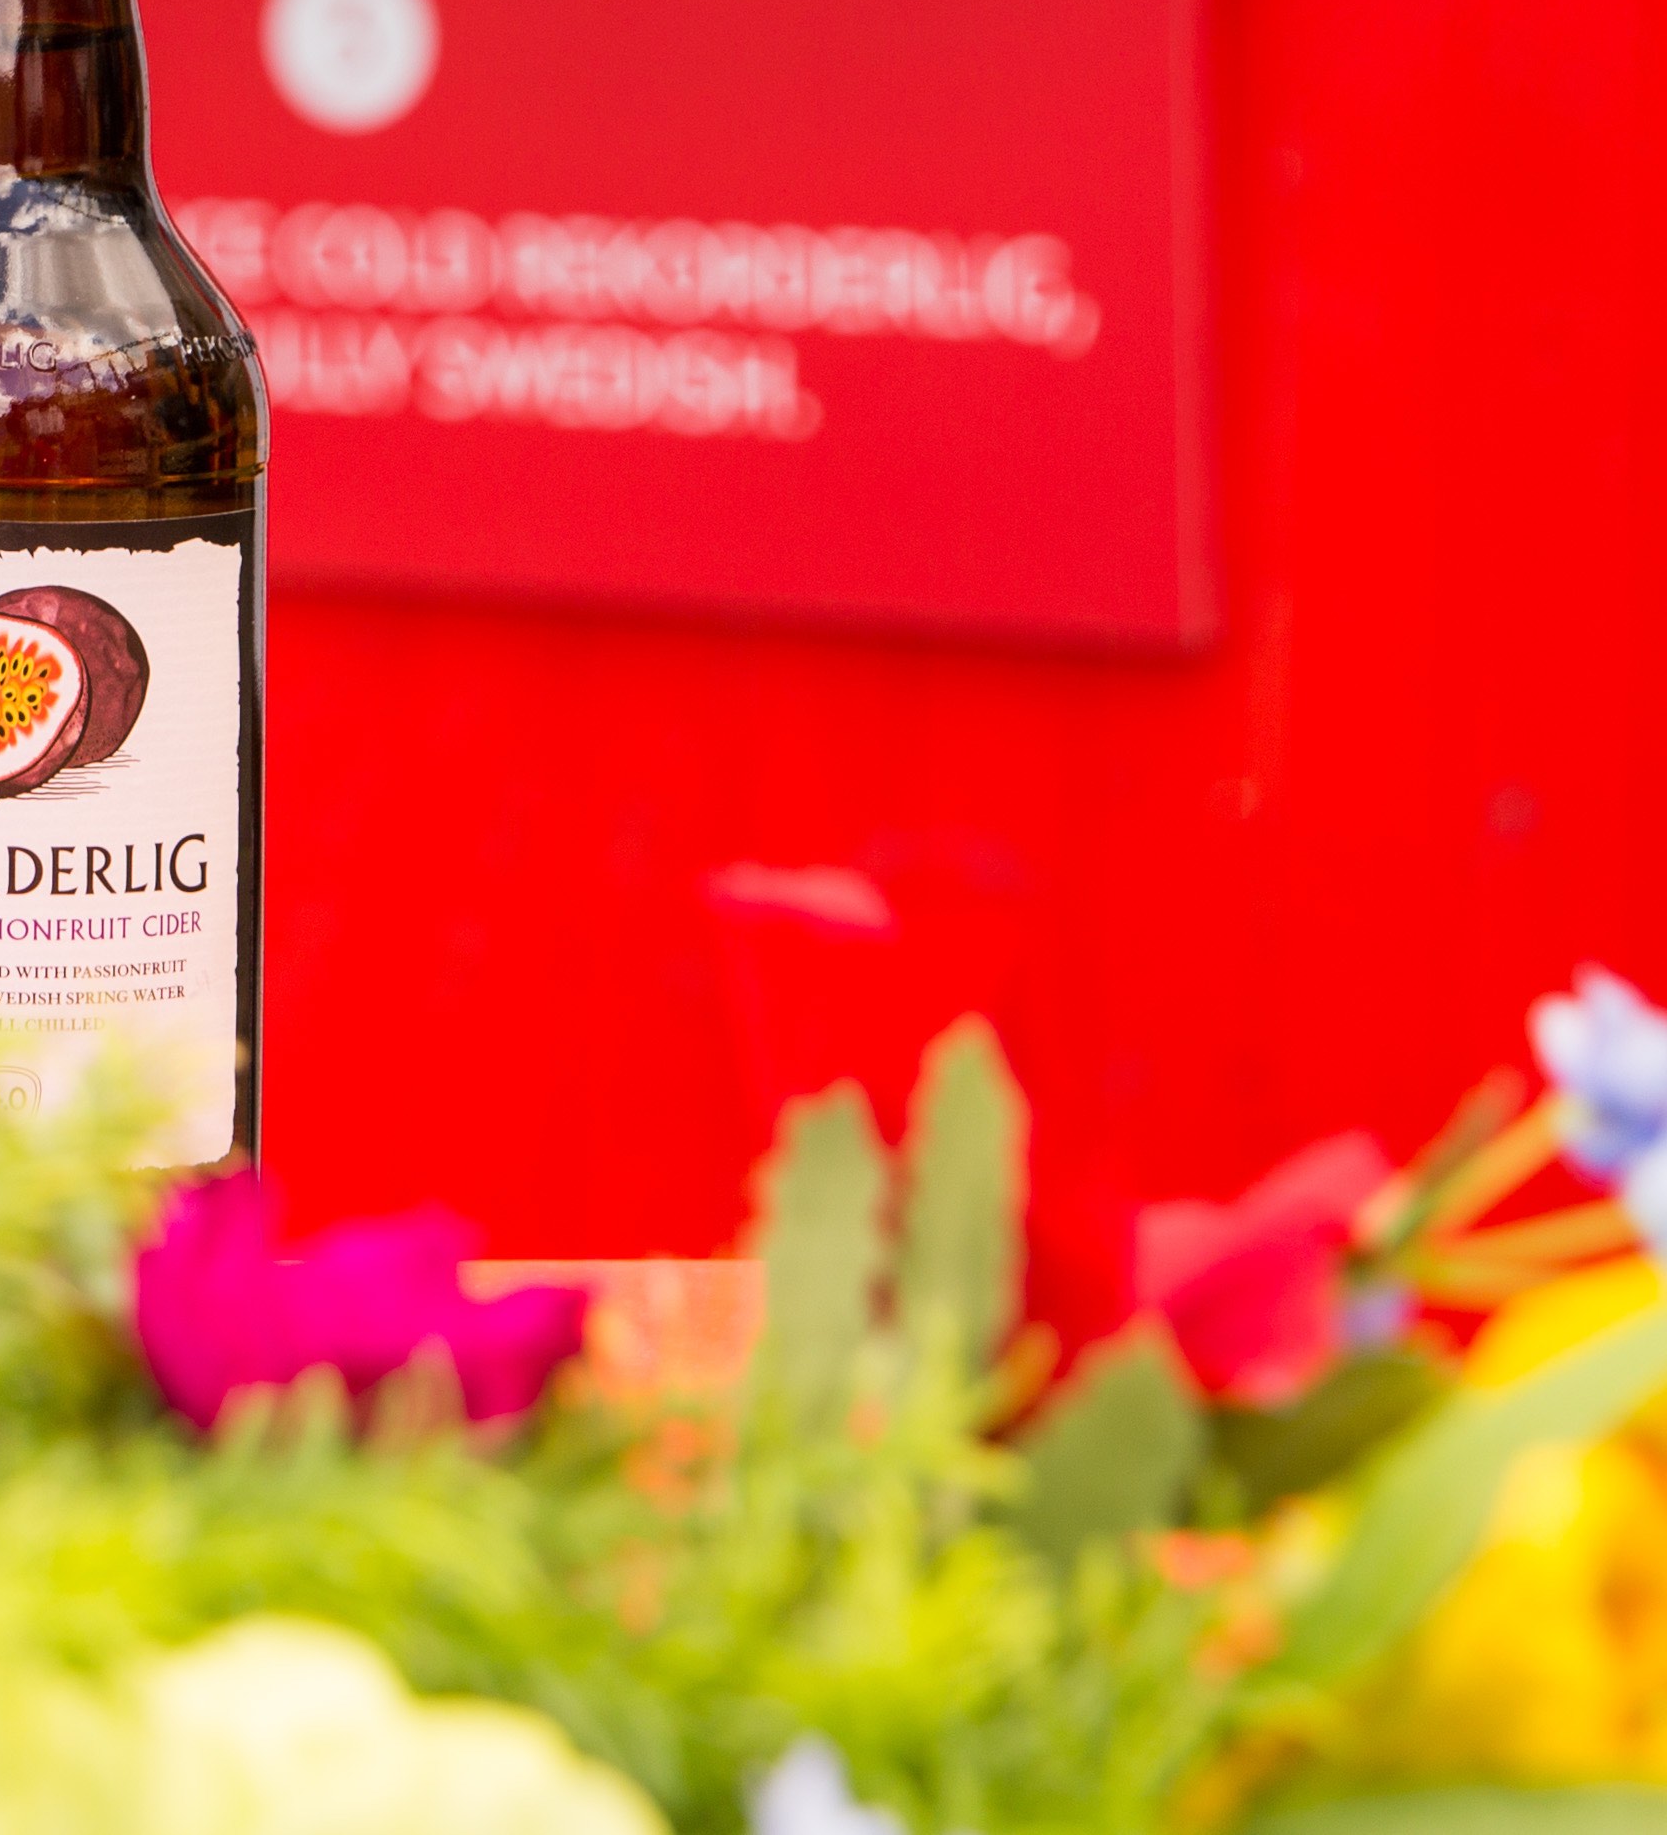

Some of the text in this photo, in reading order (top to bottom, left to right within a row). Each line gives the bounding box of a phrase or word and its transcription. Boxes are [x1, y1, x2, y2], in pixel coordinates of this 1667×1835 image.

[142, 910, 202, 938] CIDER
[16, 966, 67, 979] WITH
[72, 959, 187, 979] PASSIONFRUIT
[65, 990, 129, 1006] SPRING
[133, 985, 186, 1002] WATER
